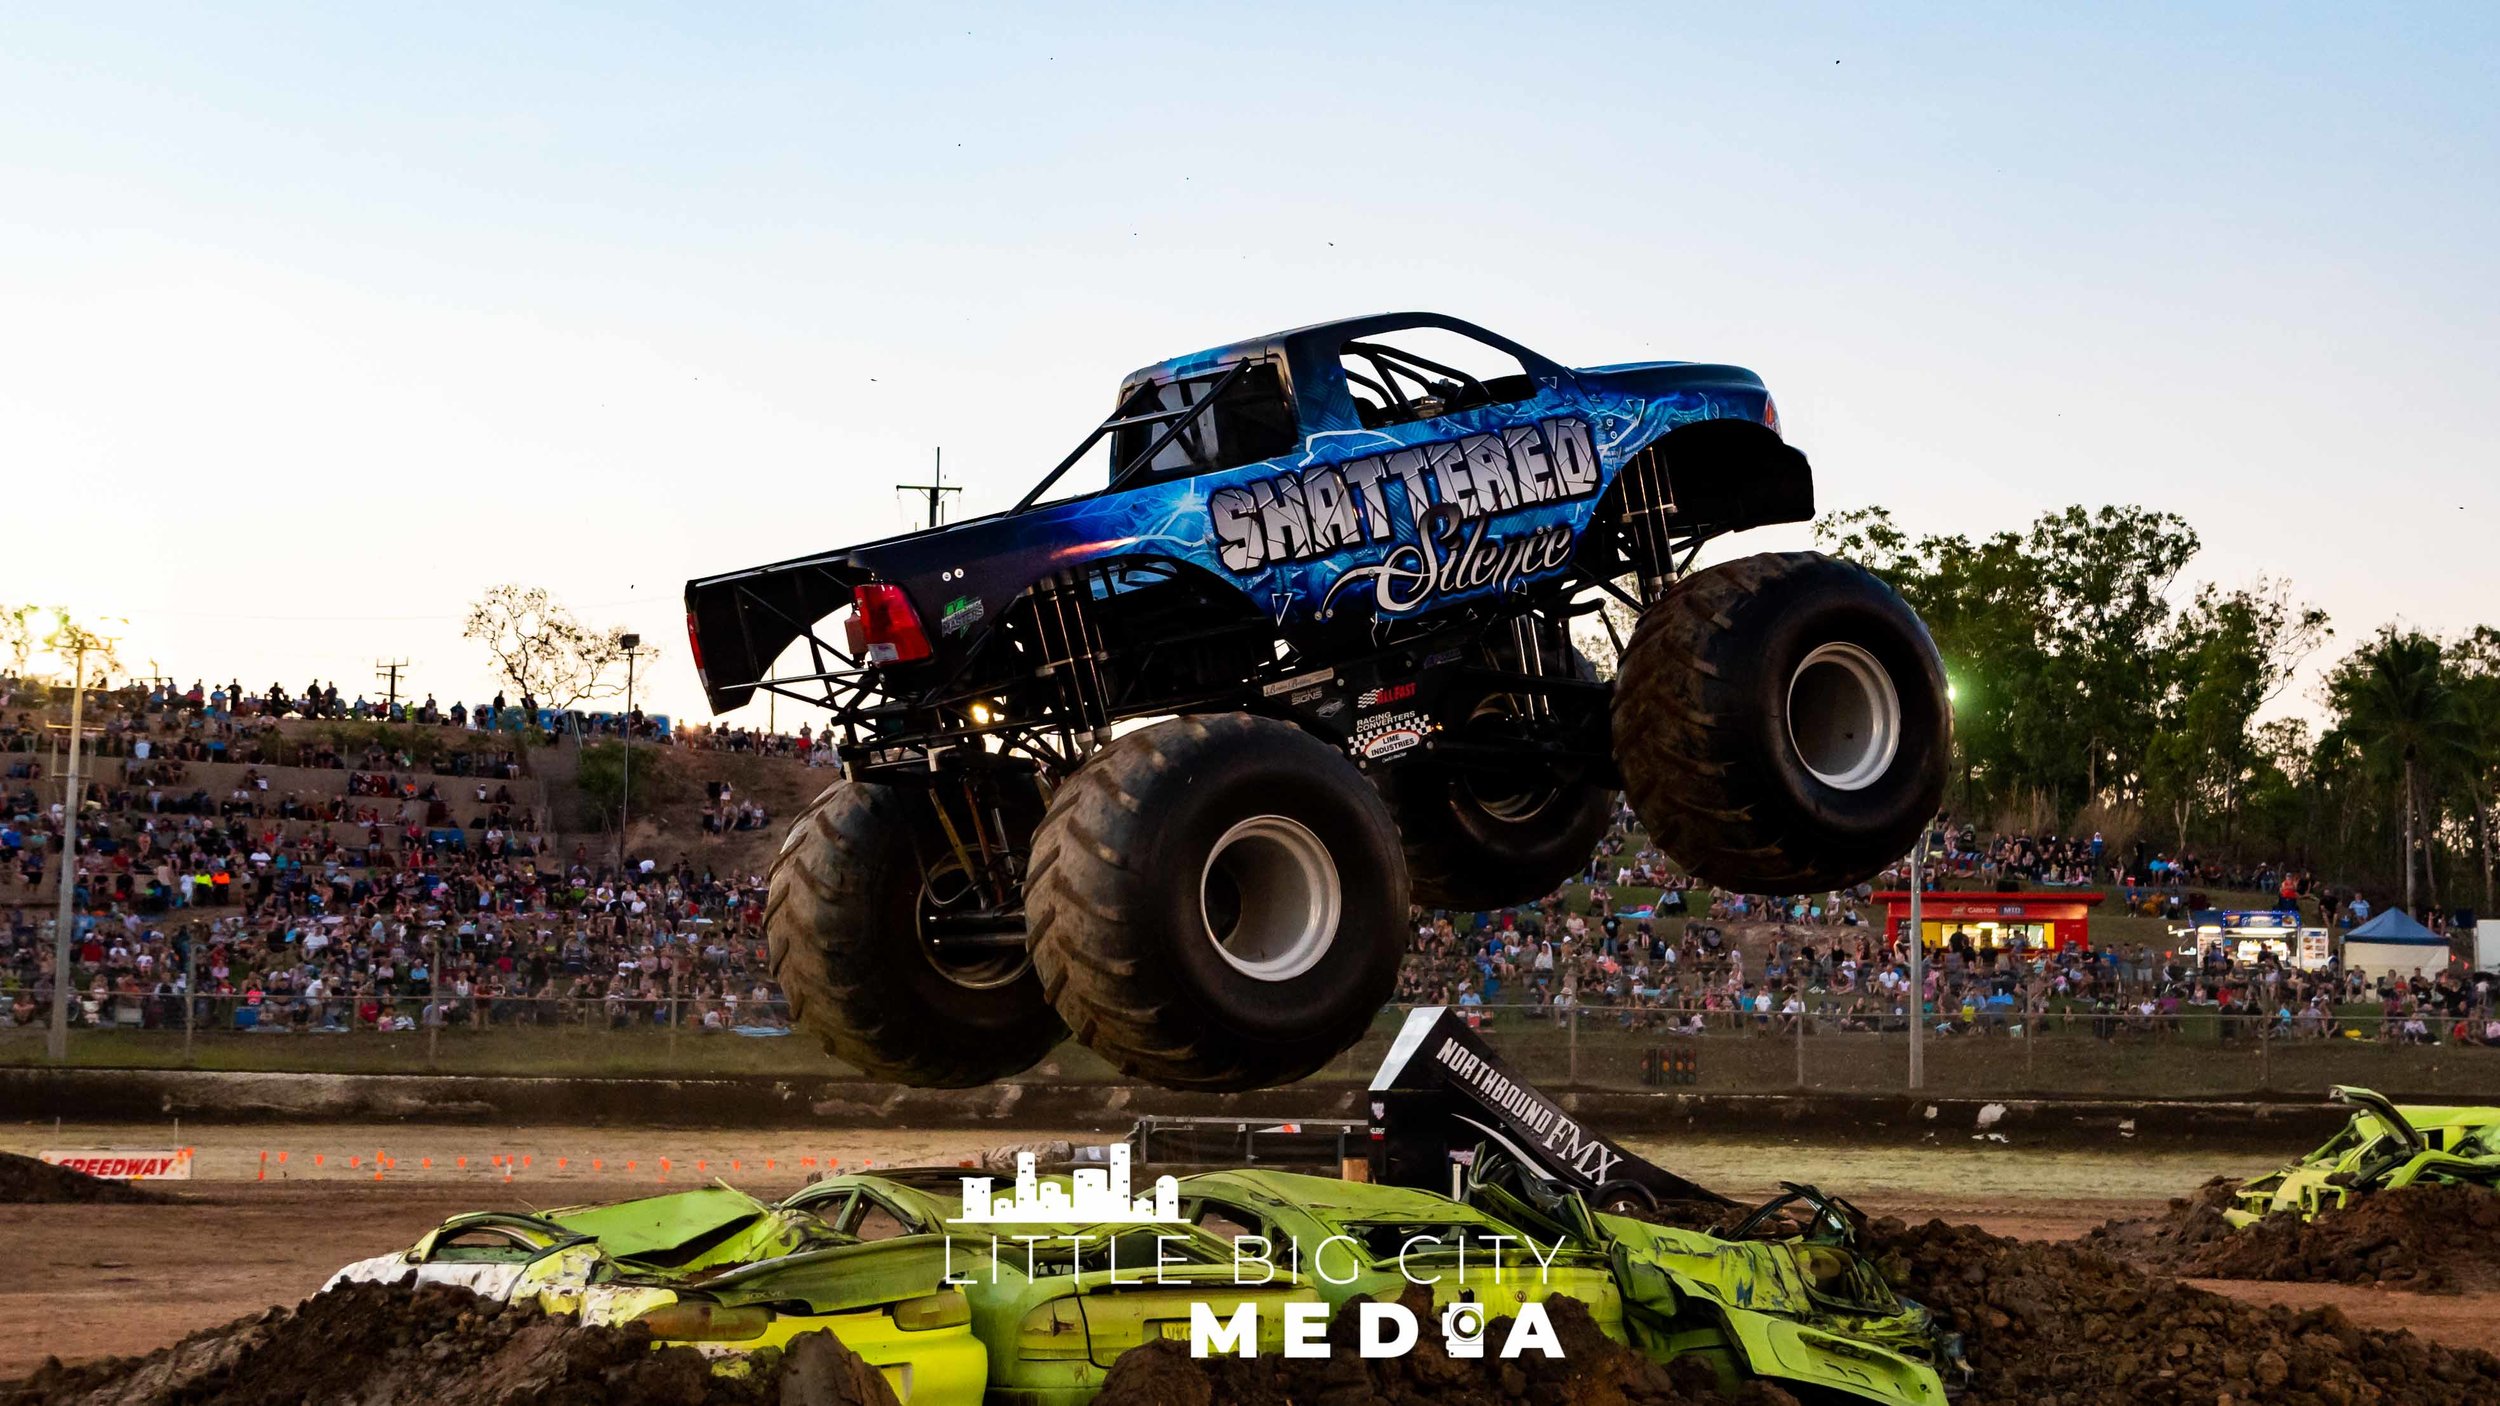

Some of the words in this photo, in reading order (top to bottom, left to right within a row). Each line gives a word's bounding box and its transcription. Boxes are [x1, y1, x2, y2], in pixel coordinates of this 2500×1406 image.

[1213, 417, 1599, 571] SHATTERED
[1321, 502, 1571, 612] Silence
[1356, 711, 1391, 728] RACING
[1356, 711, 1416, 732] CONVERTERS
[1371, 738, 1415, 756] INDUSTRIES
[1382, 734, 1400, 745] LIME
[1436, 1037, 1554, 1135] NORTHBOUND
[1542, 1114, 1623, 1186] FMX
